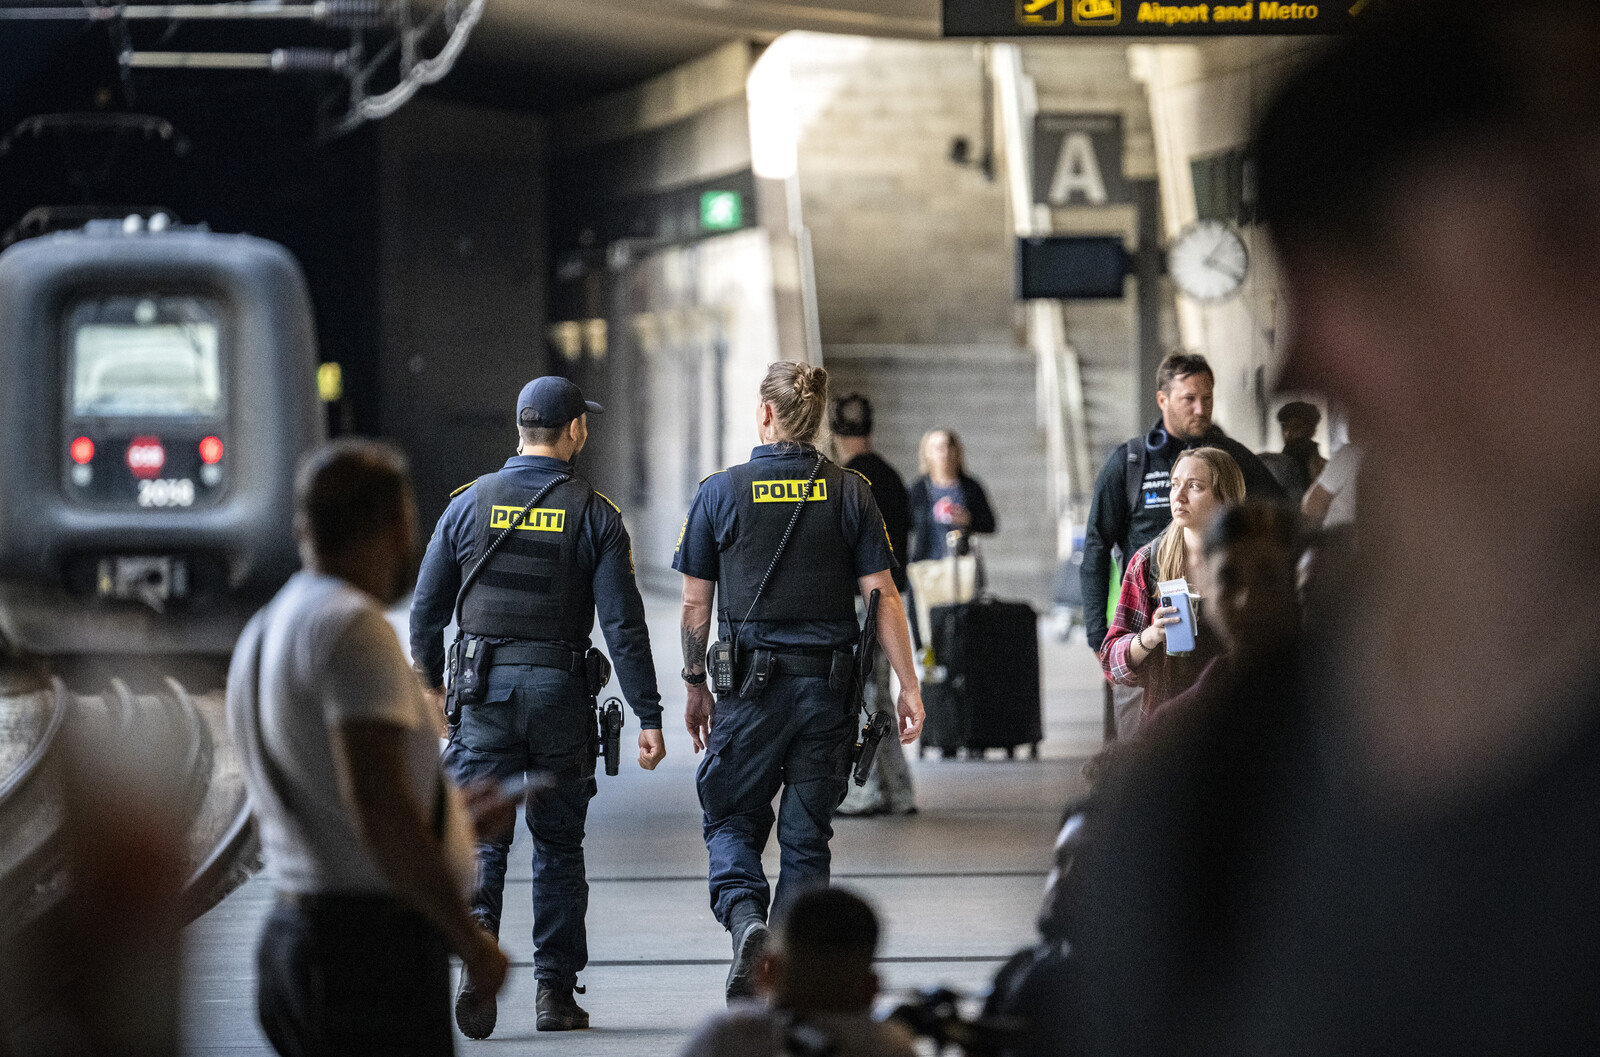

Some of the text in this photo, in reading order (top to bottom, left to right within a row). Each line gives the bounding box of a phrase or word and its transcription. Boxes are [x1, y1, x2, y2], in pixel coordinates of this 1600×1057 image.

[1137, 2, 1319, 26] Airport and Metro
[1048, 133, 1107, 204] A
[752, 482, 825, 499] POLITI
[492, 509, 563, 528] POLITI
